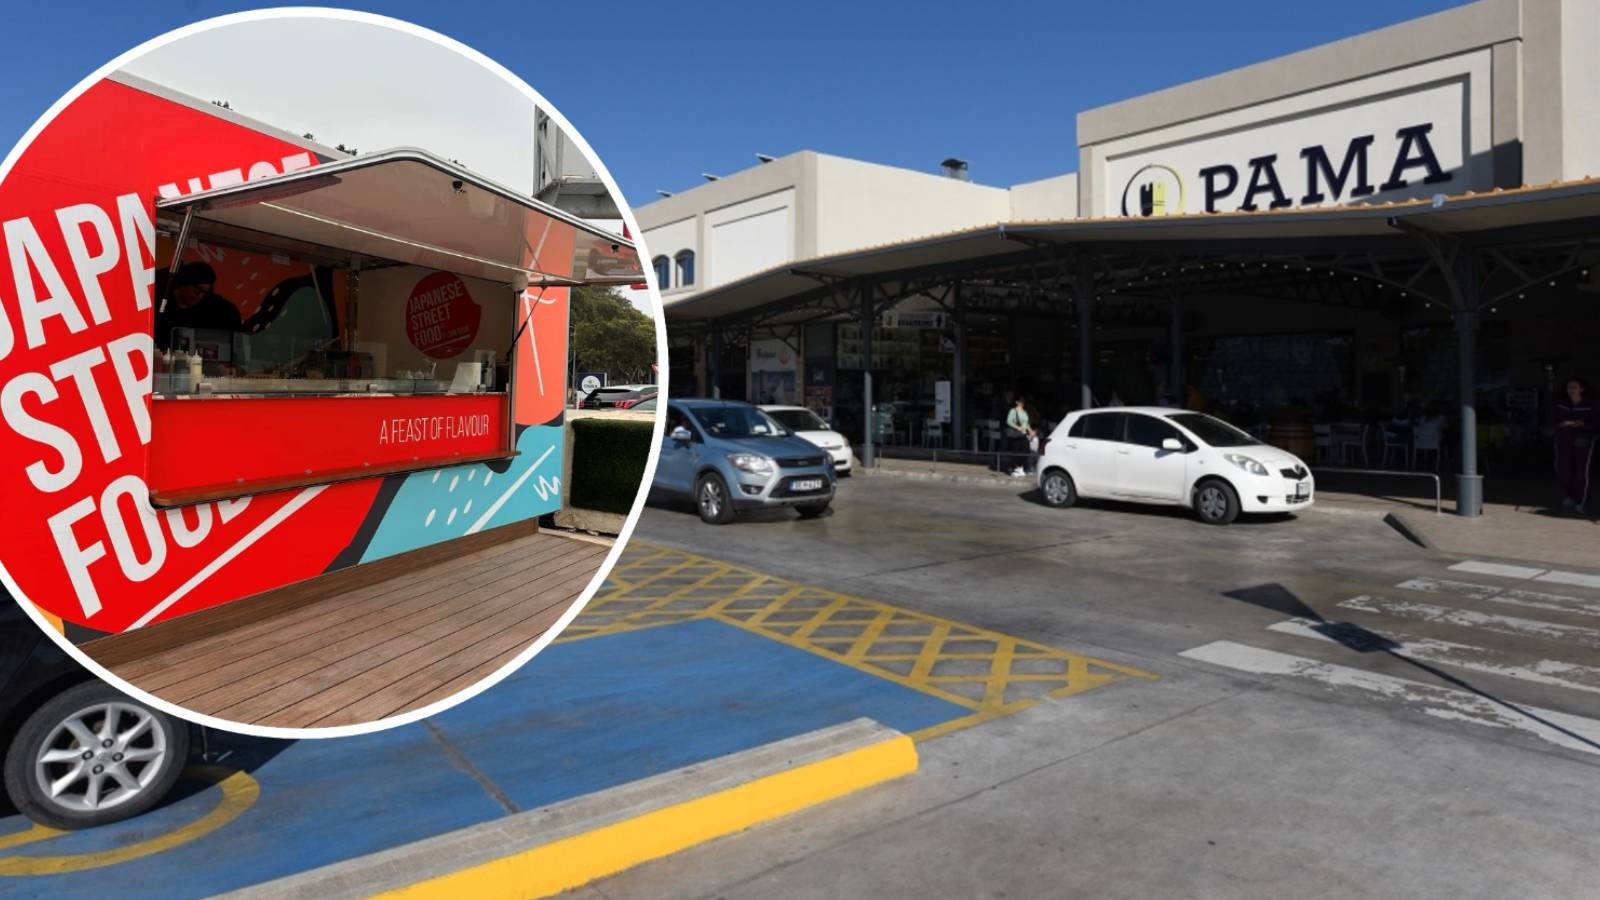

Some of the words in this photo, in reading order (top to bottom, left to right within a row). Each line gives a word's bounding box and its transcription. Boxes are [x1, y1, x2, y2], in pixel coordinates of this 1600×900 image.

[1199, 122, 1453, 214] PAMA
[409, 280, 464, 314] JAPANESE
[411, 302, 452, 330] STREET
[414, 323, 442, 348] FOOD
[0, 333, 153, 493] STR
[379, 419, 389, 445] A
[391, 417, 429, 444] FEAST
[430, 416, 444, 441] OF
[446, 414, 490, 439] FLAVOUR
[47, 474, 253, 619] FO
